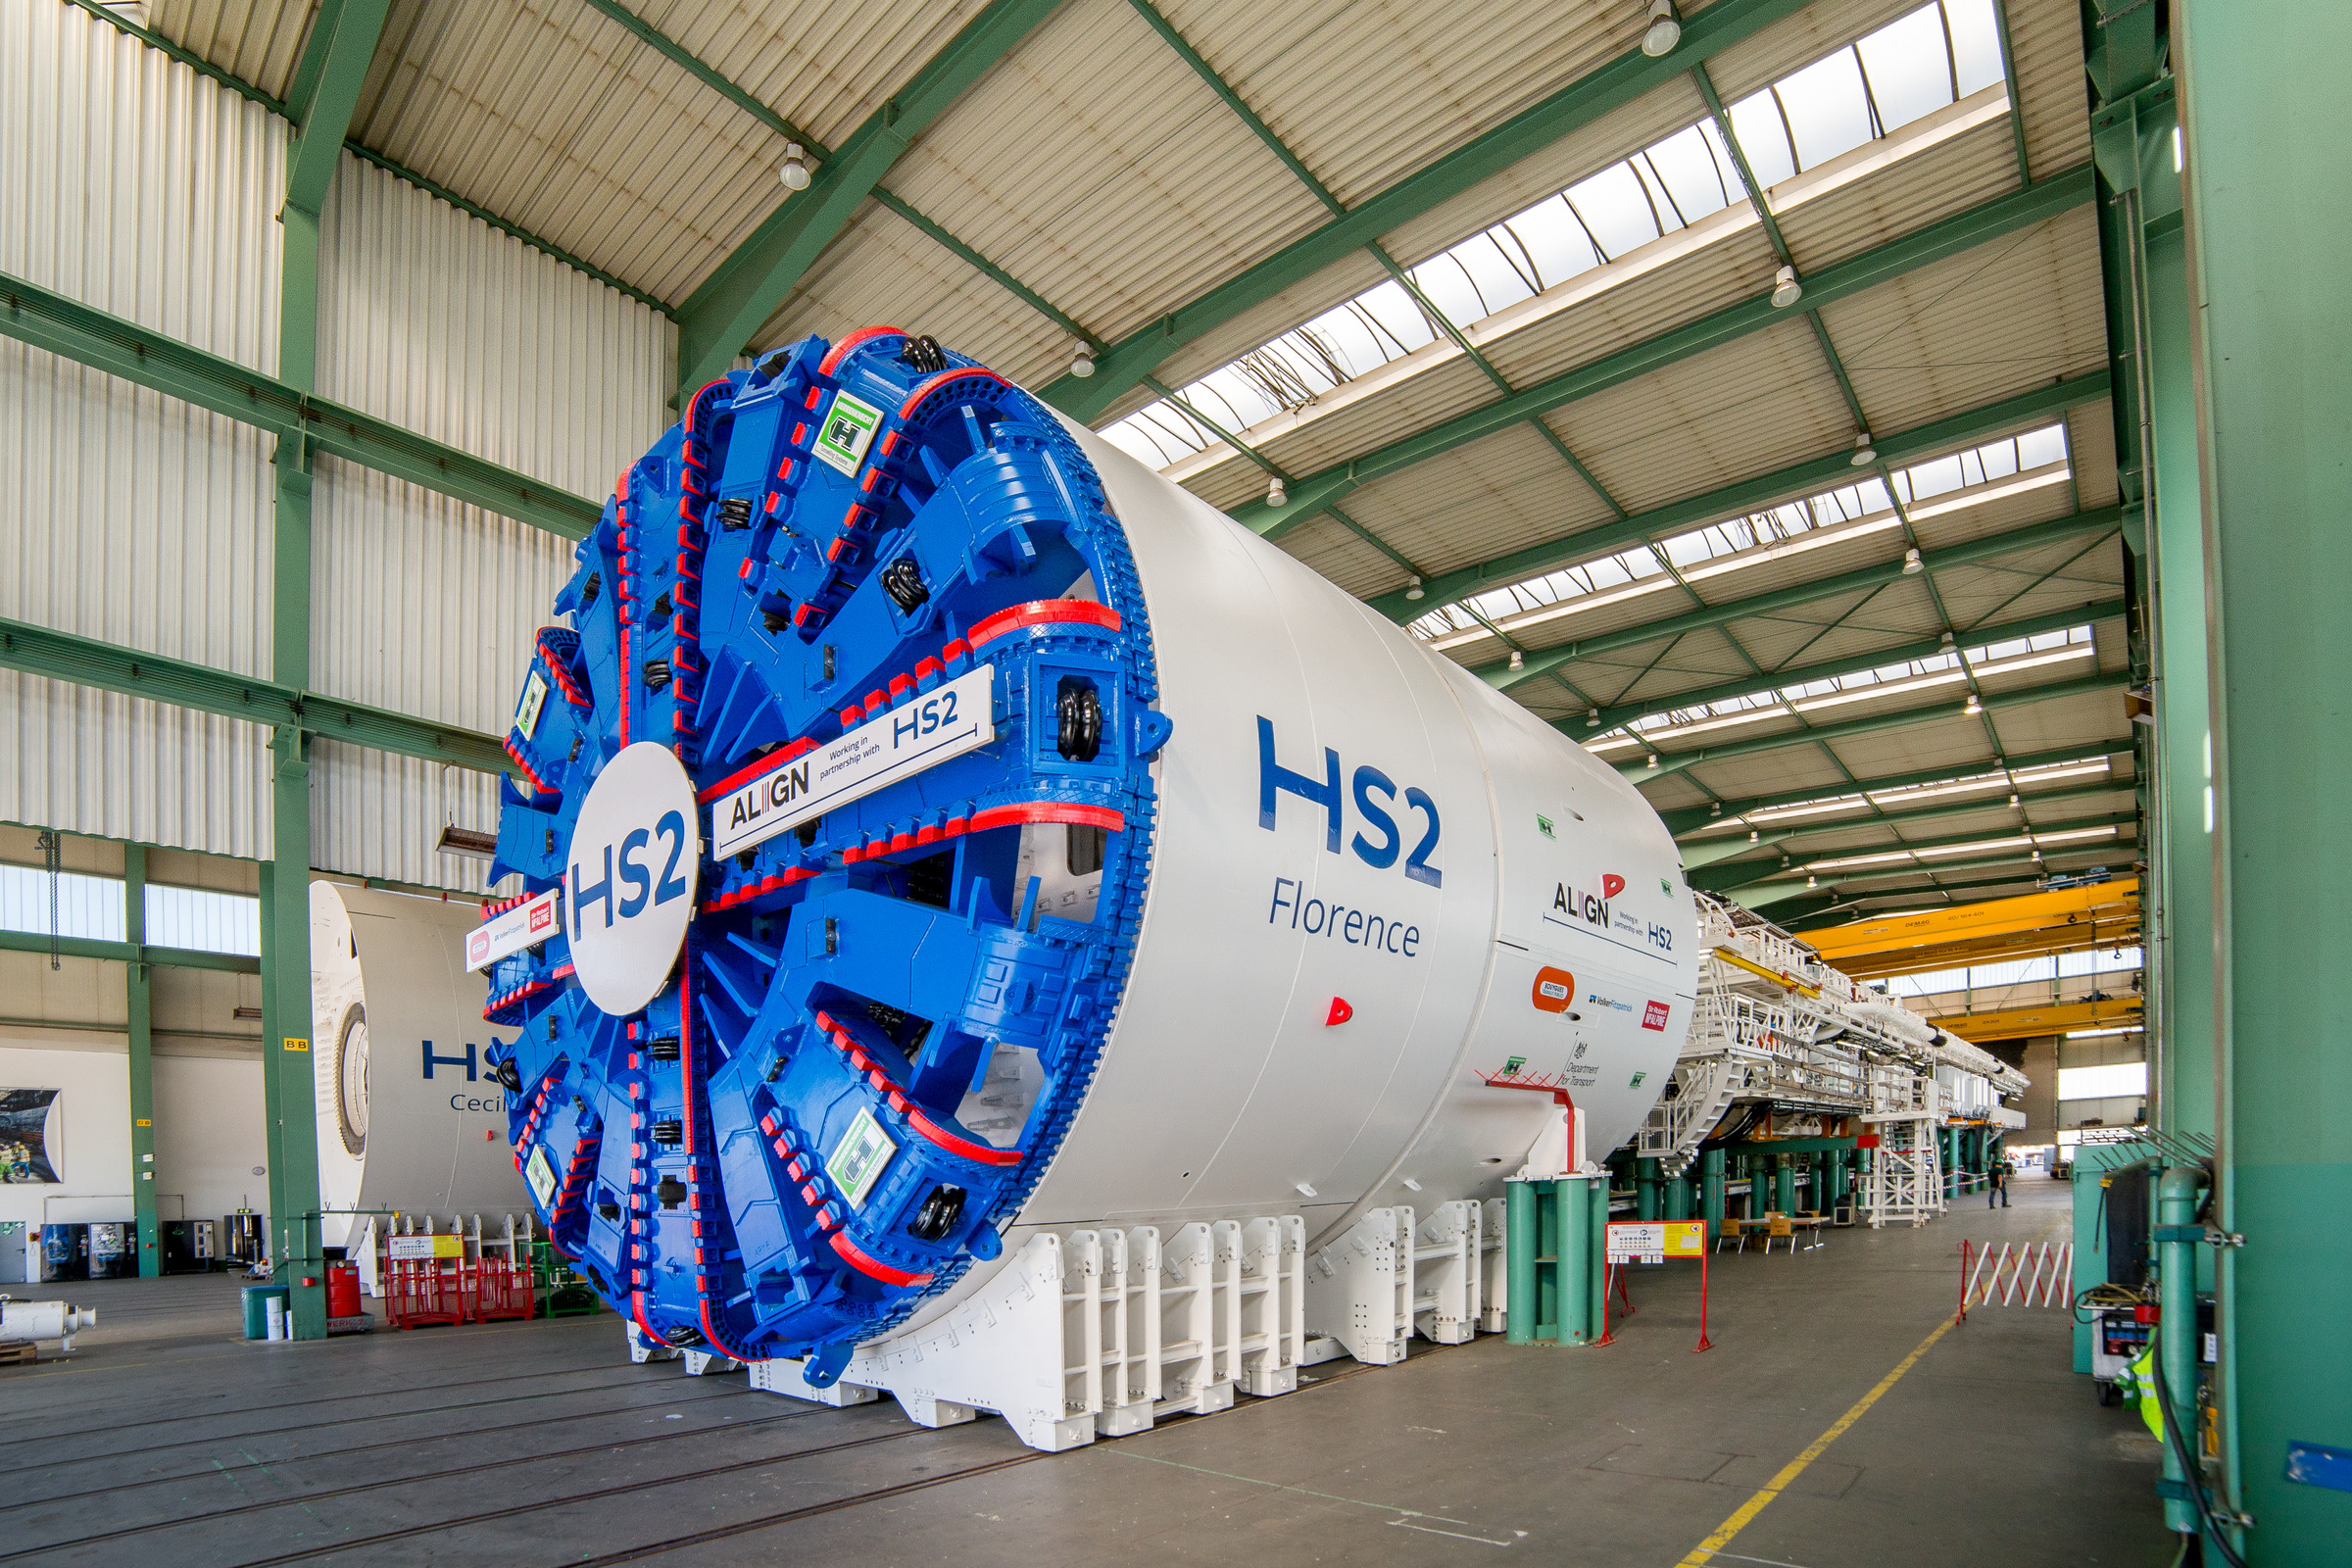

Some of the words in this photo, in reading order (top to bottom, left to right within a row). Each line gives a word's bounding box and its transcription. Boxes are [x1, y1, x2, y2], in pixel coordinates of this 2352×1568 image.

[894, 691, 957, 749] HS2
[820, 753, 860, 781] partnership
[862, 743, 880, 759] with
[829, 739, 859, 761] Working
[860, 736, 868, 747] in
[730, 761, 809, 830] ALIGN
[1256, 714, 1442, 889] HS2
[571, 809, 686, 943] HS2
[536, 906, 550, 916] Robert
[1269, 877, 1420, 957] Florence
[1553, 882, 1608, 929] ALIGN
[1619, 910, 1636, 924] Working
[1614, 920, 1636, 935] partnership
[1648, 921, 1672, 951] HS2
[1905, 919, 1930, 928] DEMAG
[1653, 1006, 1667, 1016] Robert
[1560, 1075, 1569, 1085] for
[1569, 1076, 1595, 1087] Transport
[1566, 1062, 1599, 1074] Department
